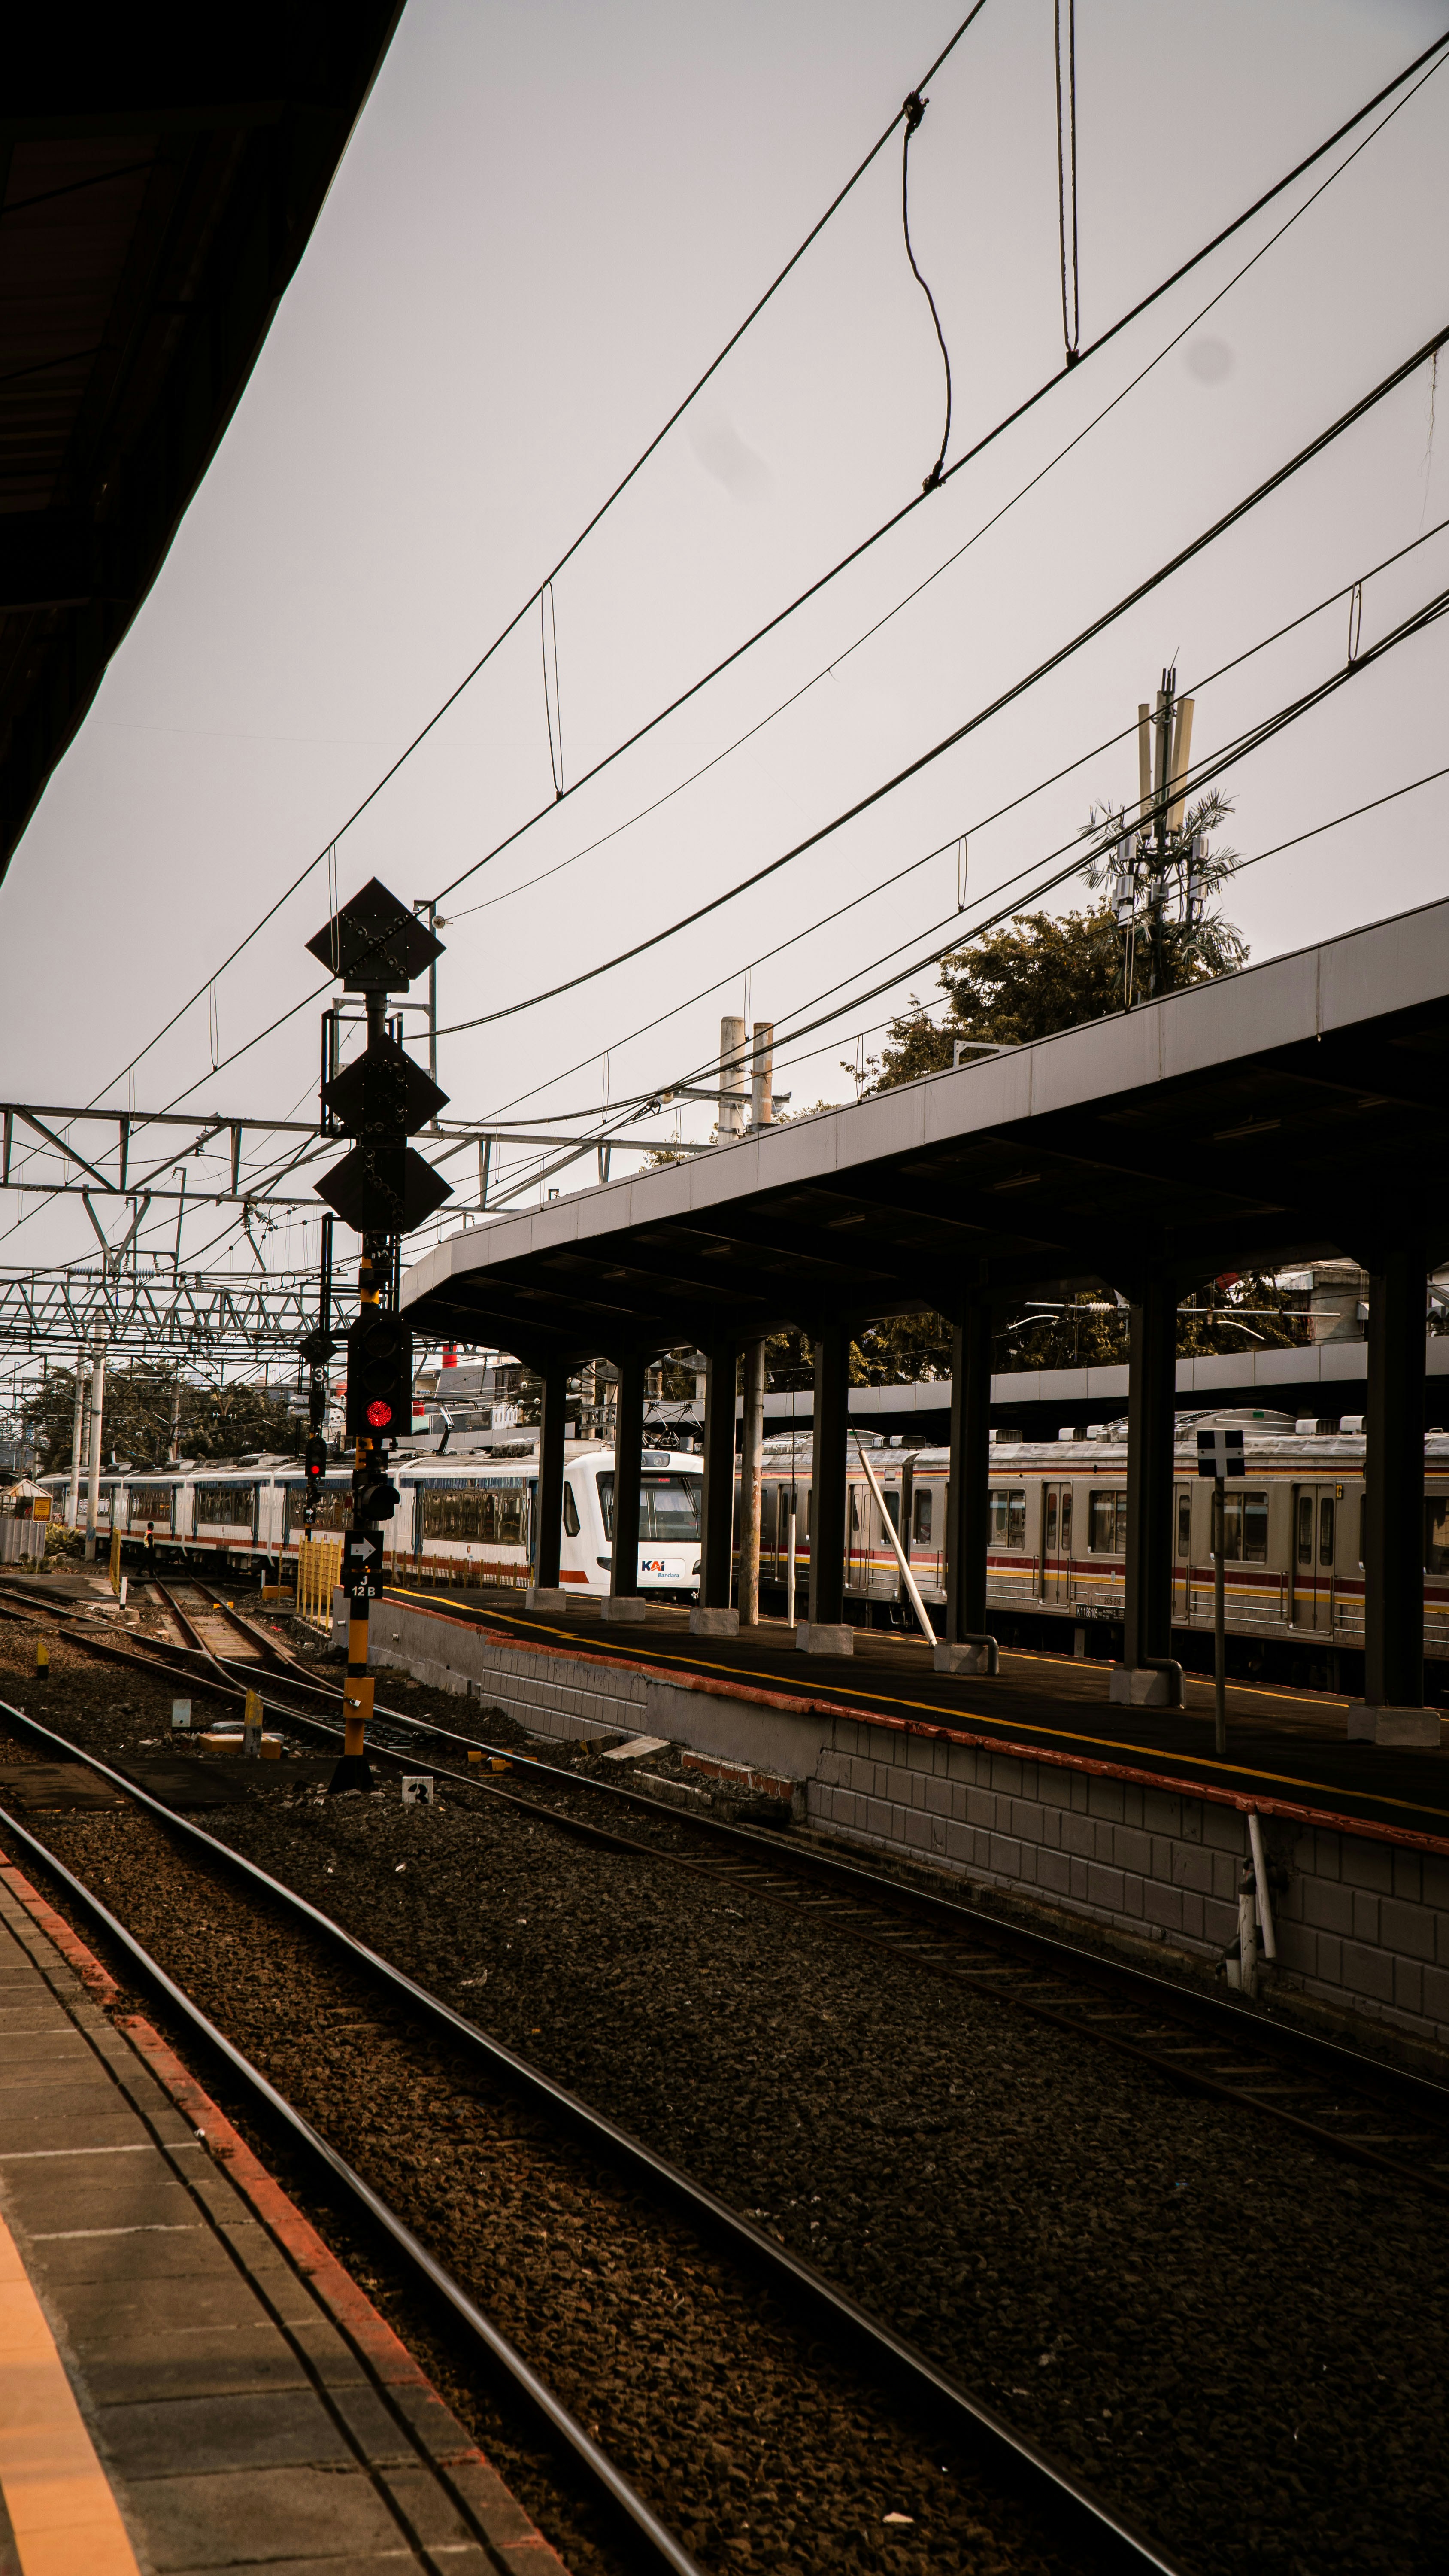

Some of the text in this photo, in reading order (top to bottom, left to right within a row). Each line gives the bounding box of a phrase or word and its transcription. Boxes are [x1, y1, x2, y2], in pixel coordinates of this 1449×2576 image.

[315, 1367, 324, 1382] 3
[642, 1561, 665, 1571] KAI
[360, 1576, 367, 1586] J
[352, 1586, 375, 1596] 12 B
[1104, 1597, 1121, 1605] 205-216
